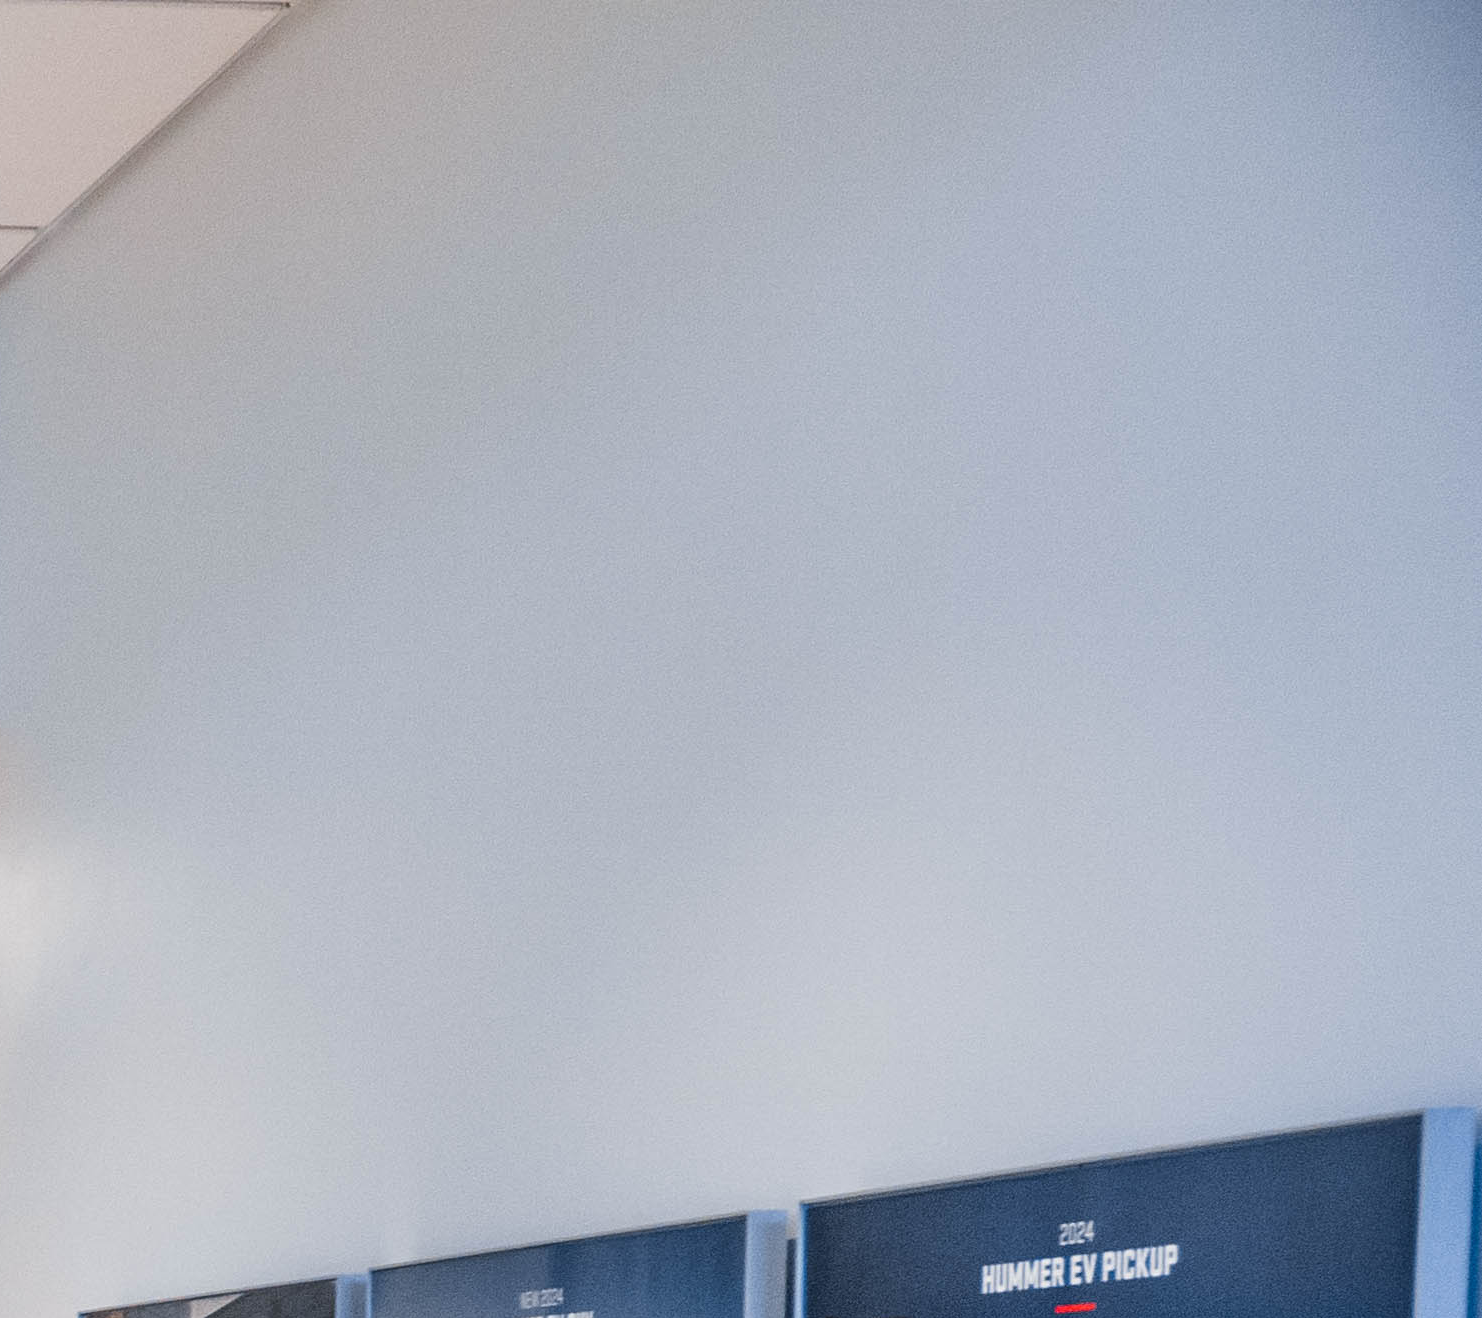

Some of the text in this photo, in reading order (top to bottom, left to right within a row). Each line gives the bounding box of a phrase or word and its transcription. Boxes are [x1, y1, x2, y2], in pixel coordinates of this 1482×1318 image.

[1058, 1219, 1096, 1246] 2024
[979, 1243, 1180, 1294] HUMMER EV PICKUP
